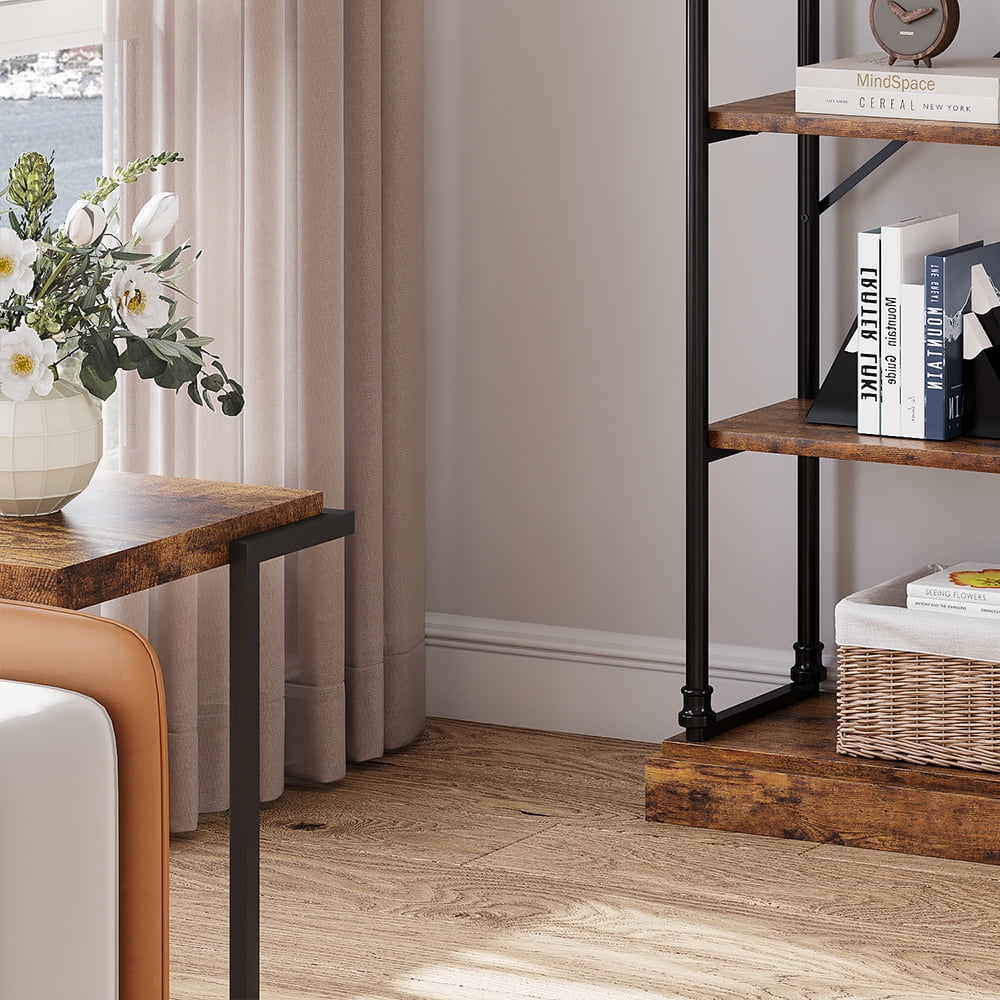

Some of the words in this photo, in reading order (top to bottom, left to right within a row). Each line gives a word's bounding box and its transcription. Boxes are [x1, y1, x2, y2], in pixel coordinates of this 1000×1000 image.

[856, 72, 936, 92] MindSpace
[859, 96, 916, 111] CEREAL
[922, 103, 944, 111] NEW
[946, 104, 972, 113] YORK
[925, 588, 951, 598] SEEING
[953, 591, 986, 601] FLOWERS
